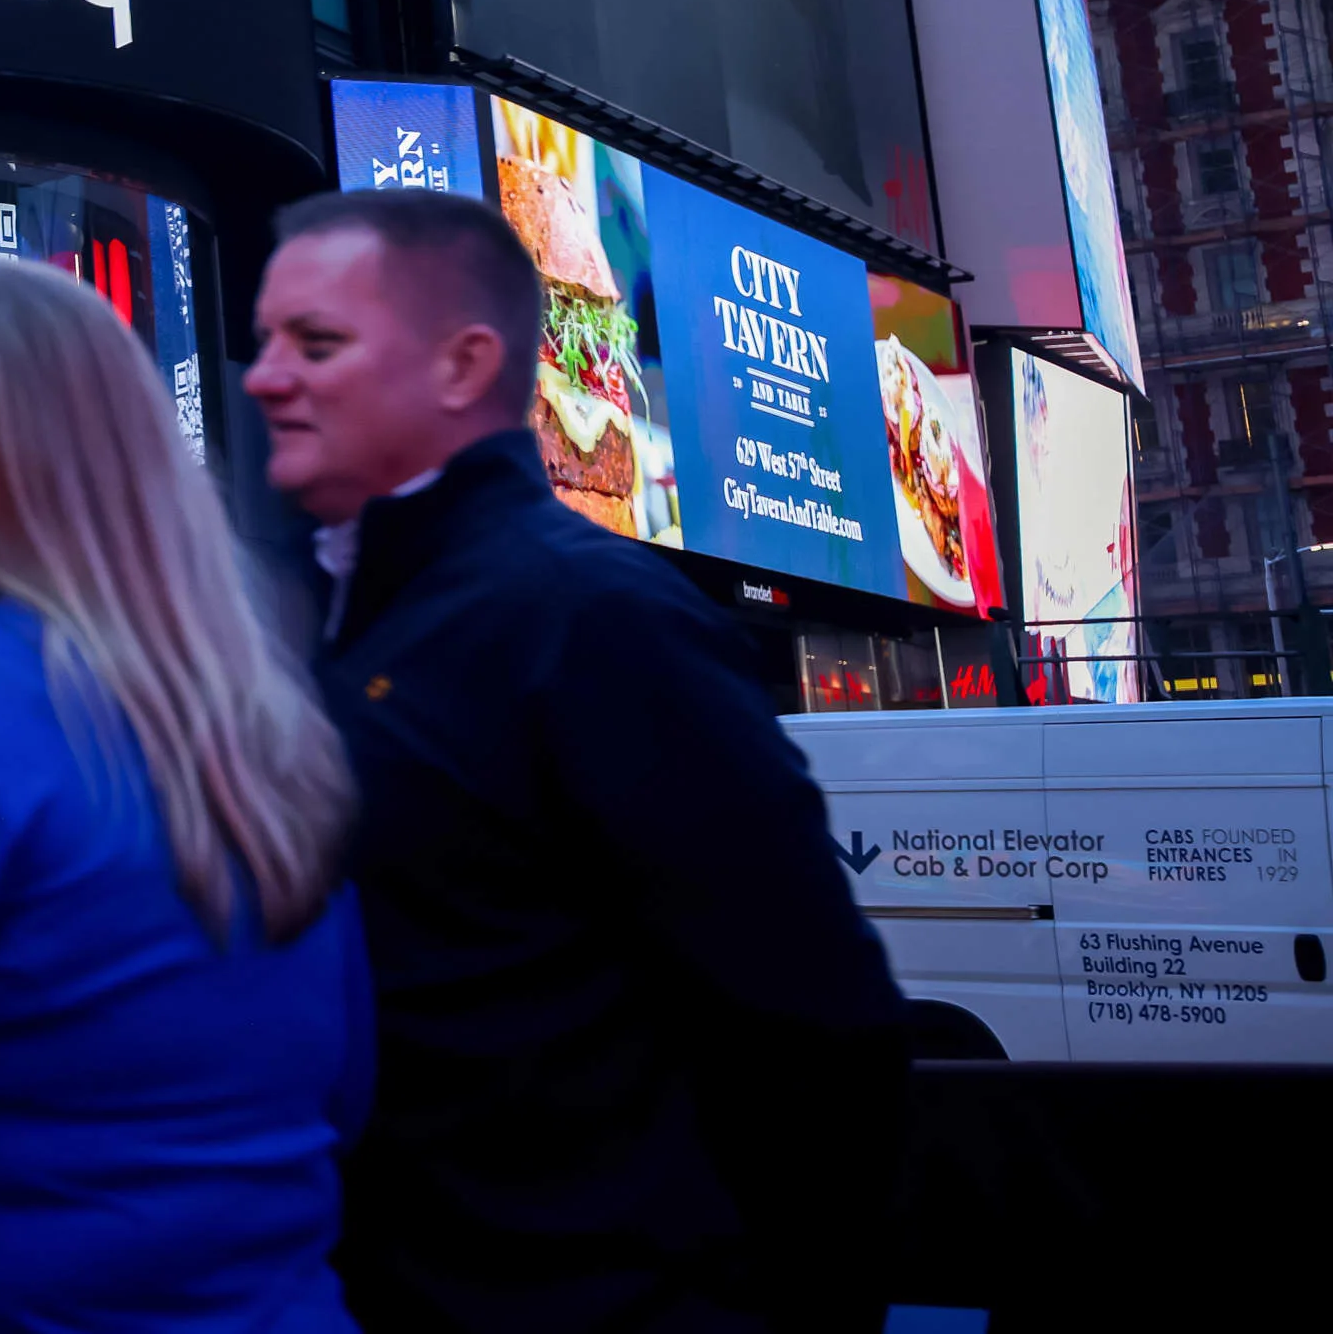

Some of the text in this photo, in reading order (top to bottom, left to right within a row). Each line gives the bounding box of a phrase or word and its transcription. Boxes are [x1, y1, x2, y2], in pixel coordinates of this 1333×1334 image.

[730, 245, 802, 317] CITY
[713, 296, 830, 383] TAVERN
[752, 379, 774, 403] AND
[777, 388, 811, 415] TABLE
[735, 436, 842, 493] 629 West 57th Street
[724, 477, 863, 541] CityTavernAndTable.com
[892, 830, 1105, 852] National Elevator
[1145, 829, 1295, 844] CABS FOUNDED
[1147, 848, 1297, 863] ENTRANCES IN
[893, 855, 1108, 884] Cab & Door Corp
[1149, 866, 1298, 882] FIXTURES 1929
[1080, 933, 1264, 955] 63 Flushing Avenue
[1083, 956, 1186, 978] Building 22
[1087, 980, 1268, 1002] Brooklyn, NY 11205
[1089, 1002, 1226, 1024] (718) 478-5900
